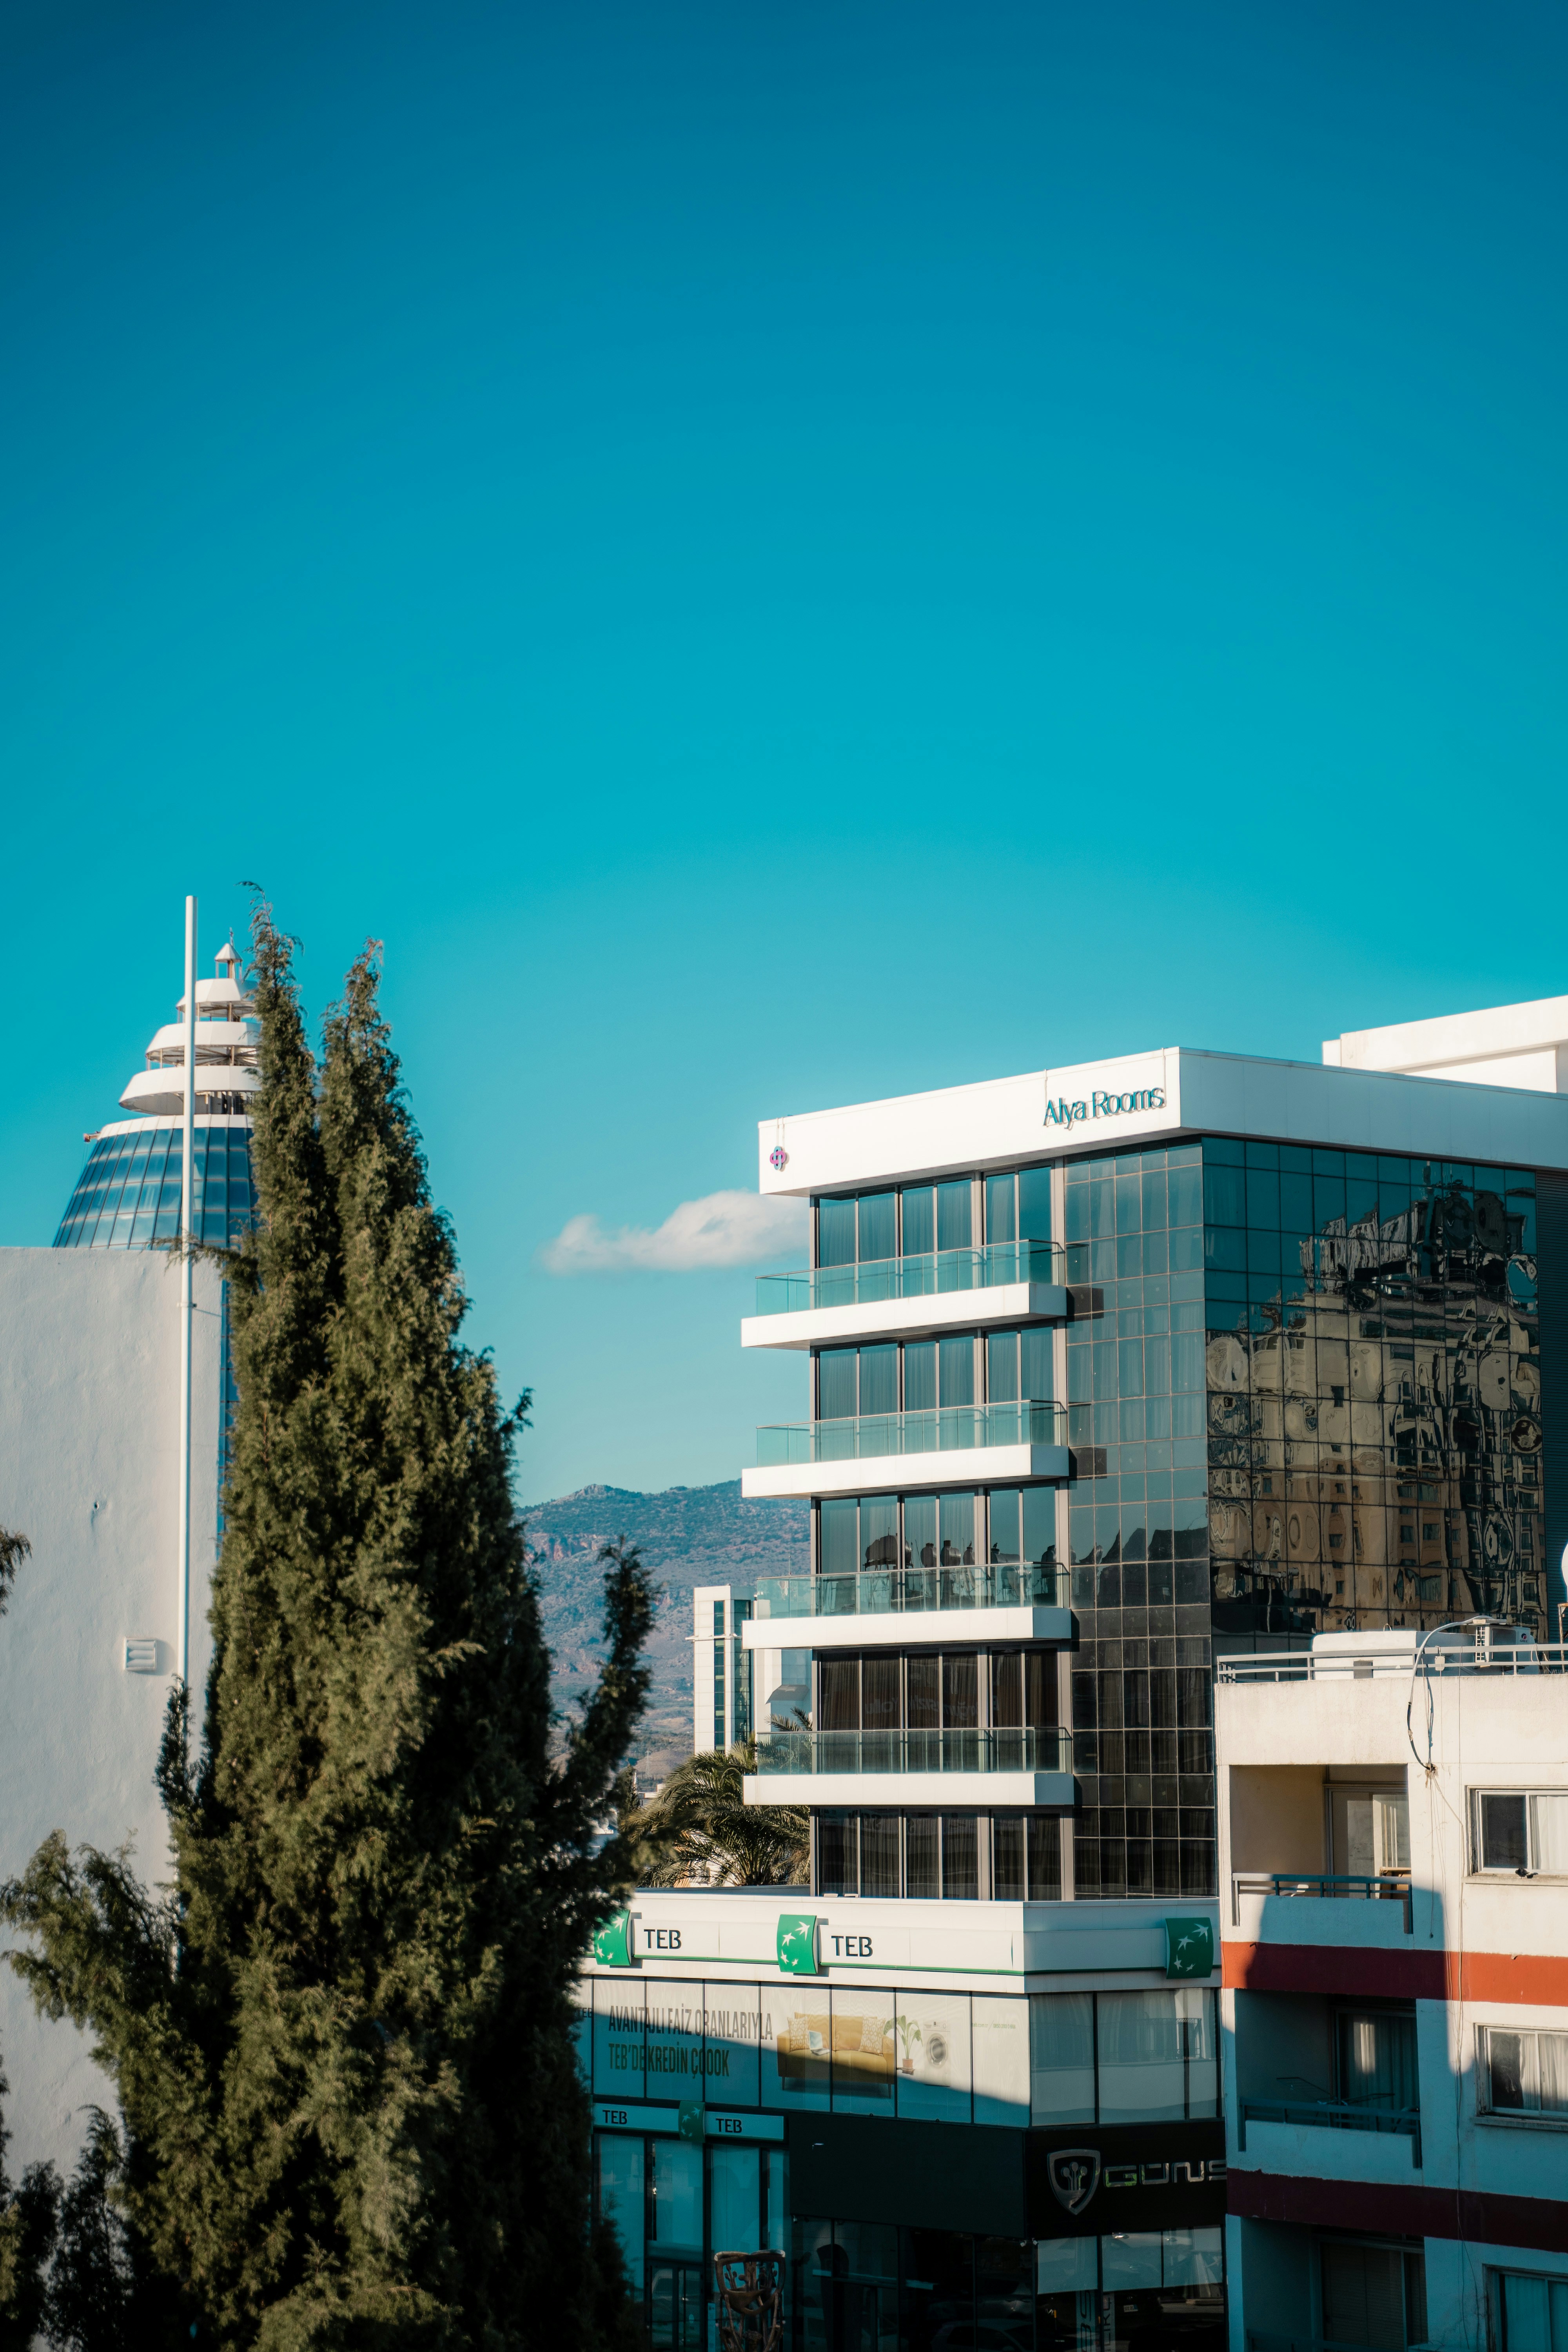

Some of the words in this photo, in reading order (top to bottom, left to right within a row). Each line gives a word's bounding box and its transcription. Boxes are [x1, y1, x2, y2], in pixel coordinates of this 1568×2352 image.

[1043, 1097, 1086, 1129] Alya
[1092, 1087, 1164, 1118] Rooms
[644, 1929, 682, 1949] TEB
[831, 1935, 873, 1957] TEB
[608, 2005, 664, 2034] AVANTAJLI
[668, 2003, 692, 2036] FAİZ
[695, 2009, 773, 2040] ORANLARIYLA
[648, 2041, 688, 2074] KREDİN
[602, 2109, 628, 2125] TEB
[715, 2118, 742, 2134] TEB
